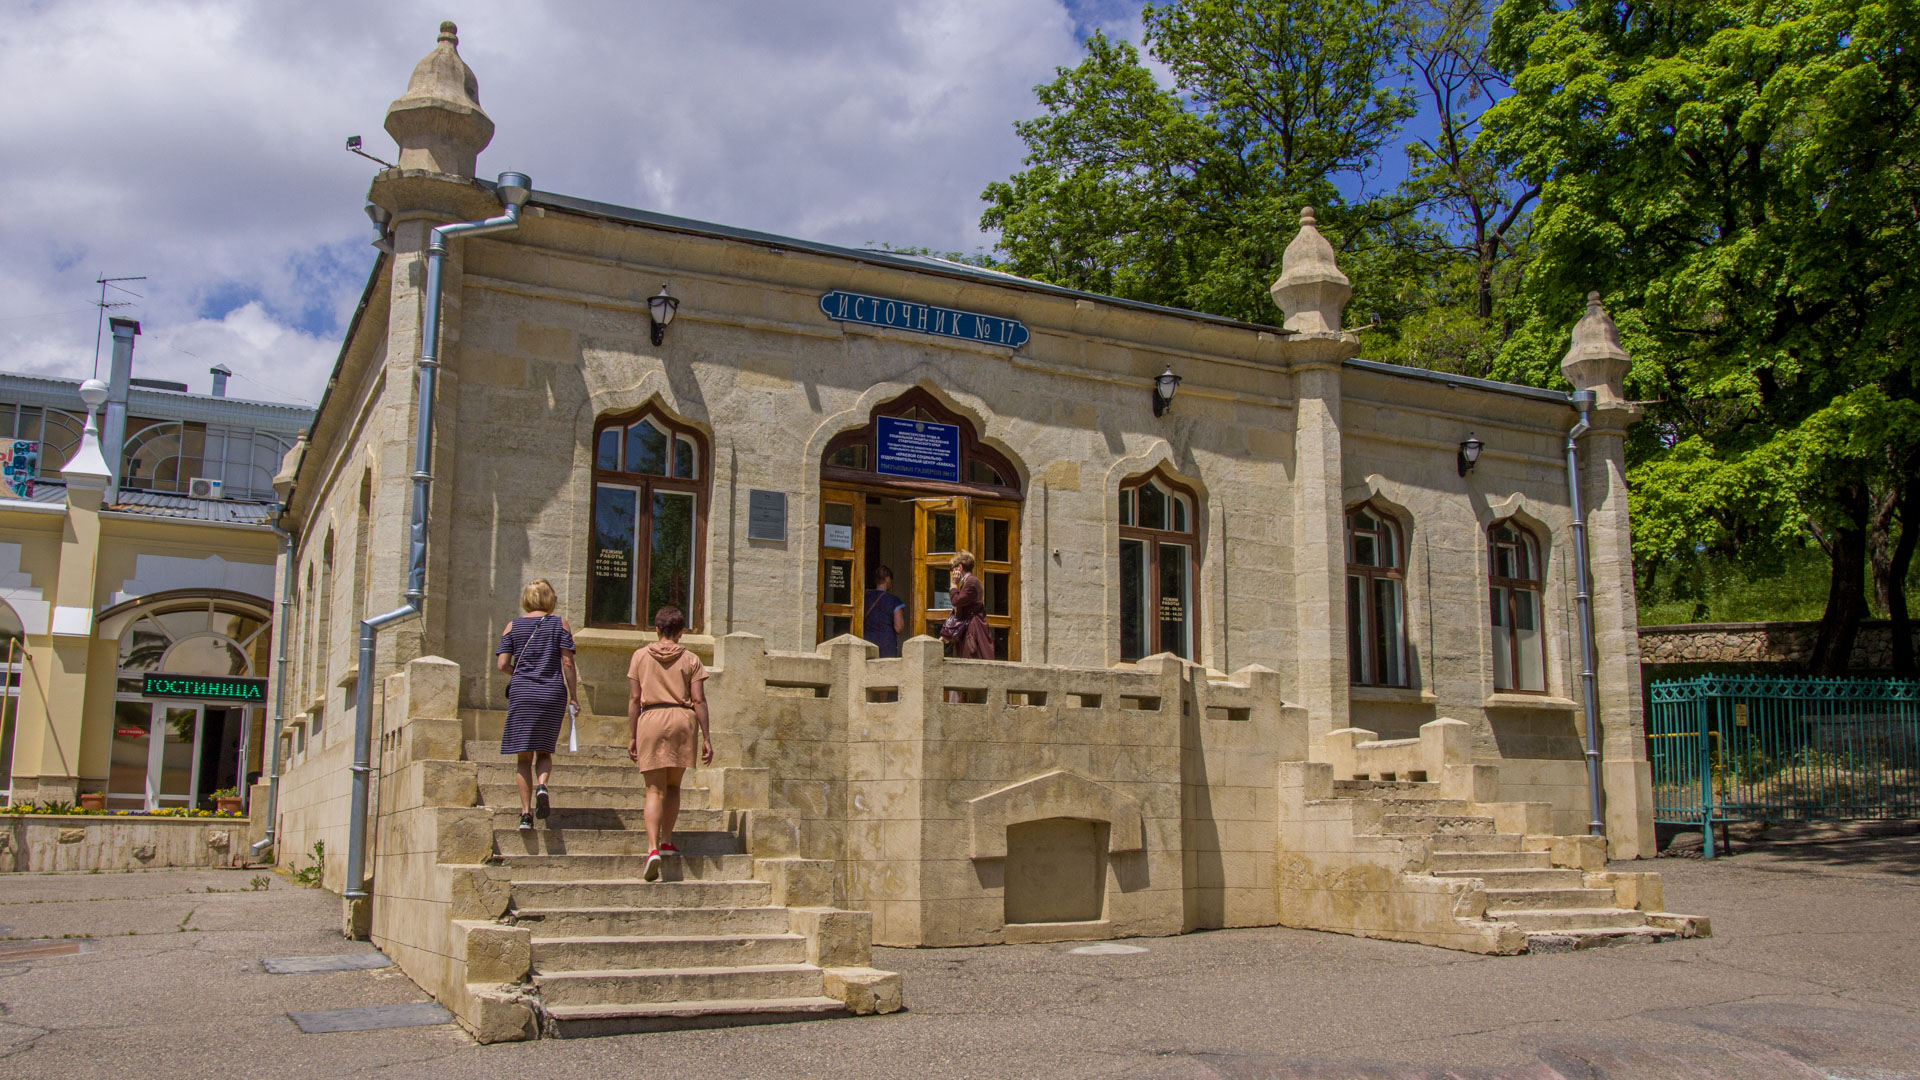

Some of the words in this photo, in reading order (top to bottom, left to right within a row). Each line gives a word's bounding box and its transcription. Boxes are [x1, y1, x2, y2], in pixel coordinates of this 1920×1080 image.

[838, 295, 961, 335] ИСТОЧНИК
[974, 316, 990, 338] №
[1000, 322, 1015, 343] 17
[146, 680, 262, 698] ГОСТИНИЦА
